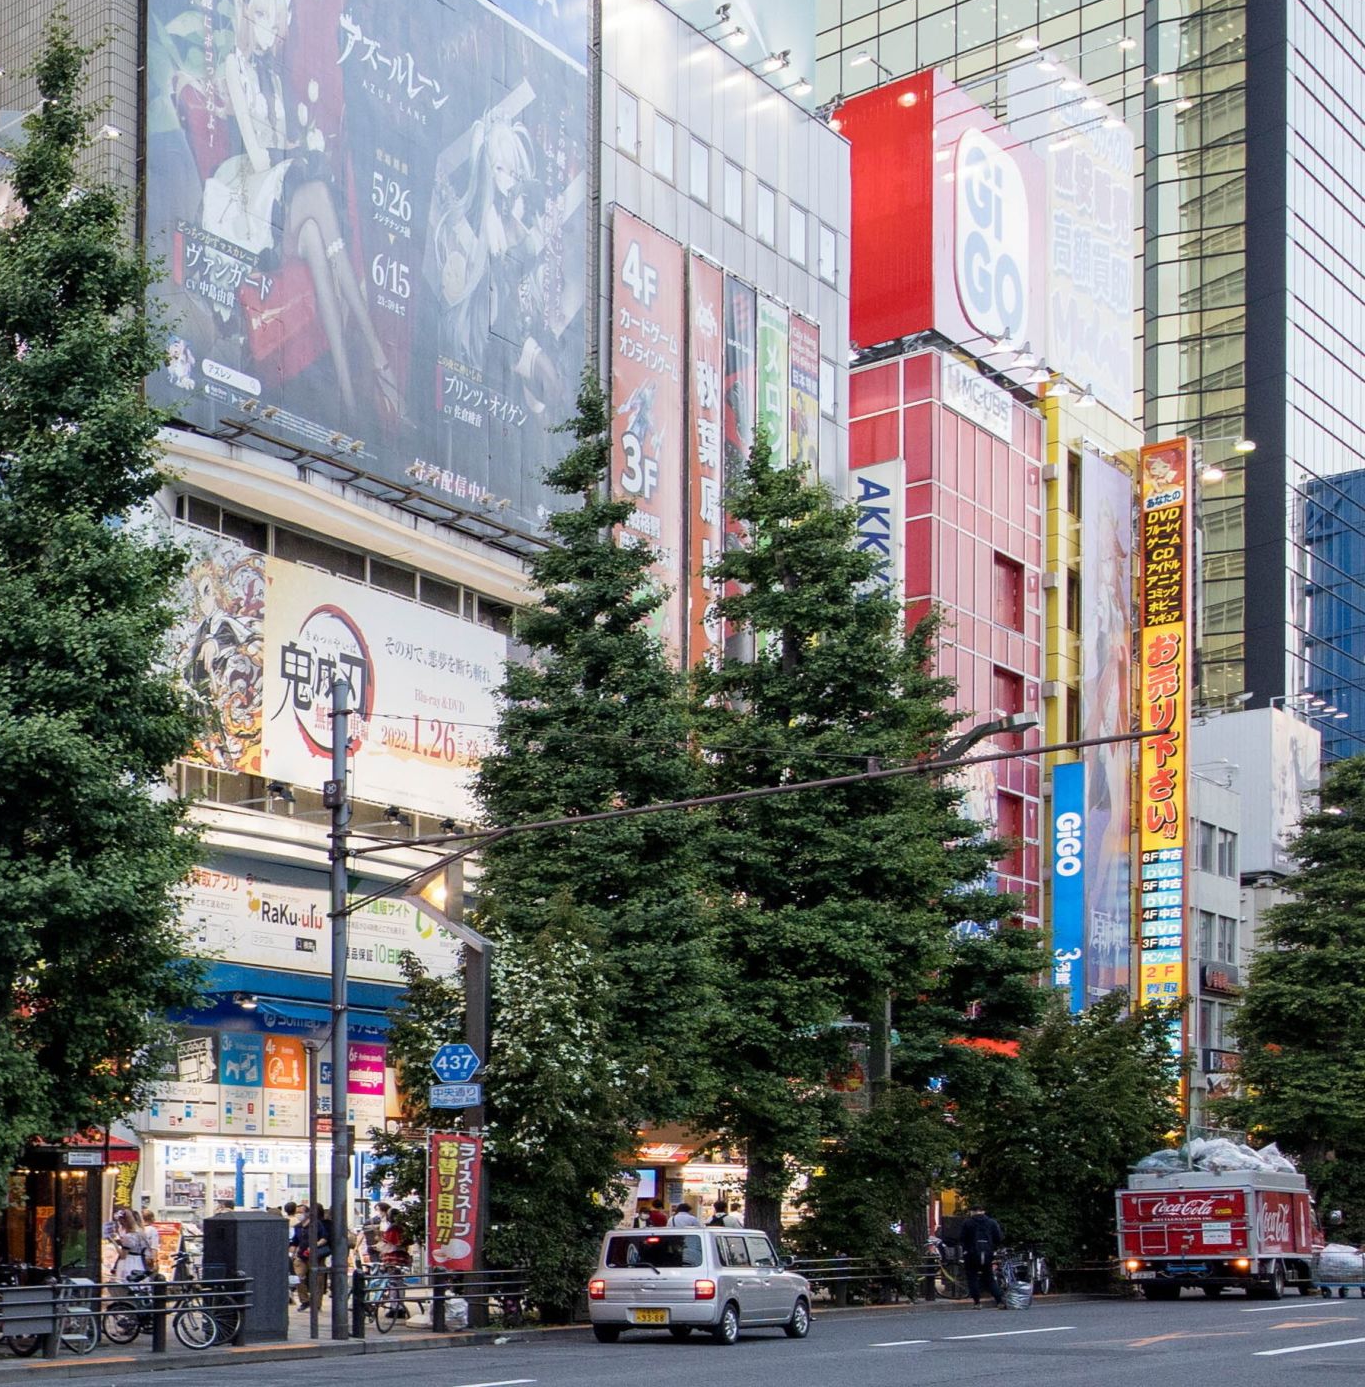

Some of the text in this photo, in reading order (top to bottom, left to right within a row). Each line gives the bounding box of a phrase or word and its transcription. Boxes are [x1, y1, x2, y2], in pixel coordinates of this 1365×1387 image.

[335, 7, 449, 111] アズールレーン
[371, 171, 413, 222] 5/26
[185, 242, 274, 301] ヴァンガード
[371, 253, 411, 300] 6/15
[621, 240, 658, 308] 4F
[619, 307, 679, 356] カードゲーム
[620, 430, 658, 500] 3F
[1145, 491, 1181, 510] あなたの
[1147, 507, 1180, 525] DVD
[1146, 533, 1181, 550] ゲーム
[1151, 547, 1175, 561] CD
[1146, 560, 1181, 575] アイドル
[1145, 572, 1181, 588] アニメ
[1147, 585, 1180, 601] コミック
[1148, 599, 1180, 613] ホビー
[1146, 611, 1181, 626] フィギュア
[1055, 811, 1082, 877] GiGO
[1145, 866, 1180, 879] DVD
[1145, 894, 1181, 908] DVD
[1145, 922, 1181, 936] DVD
[1146, 981, 1179, 995] 買取
[221, 1037, 233, 1052] 3F
[265, 1038, 277, 1053] 4F
[348, 1049, 358, 1063] 6F
[436, 1054, 474, 1071] 437
[320, 1068, 332, 1083] 5F
[432, 1087, 476, 1098] 中央通り
[1151, 1198, 1216, 1217] Coca-Cola
[1256, 1200, 1291, 1244] Coca-Cola
